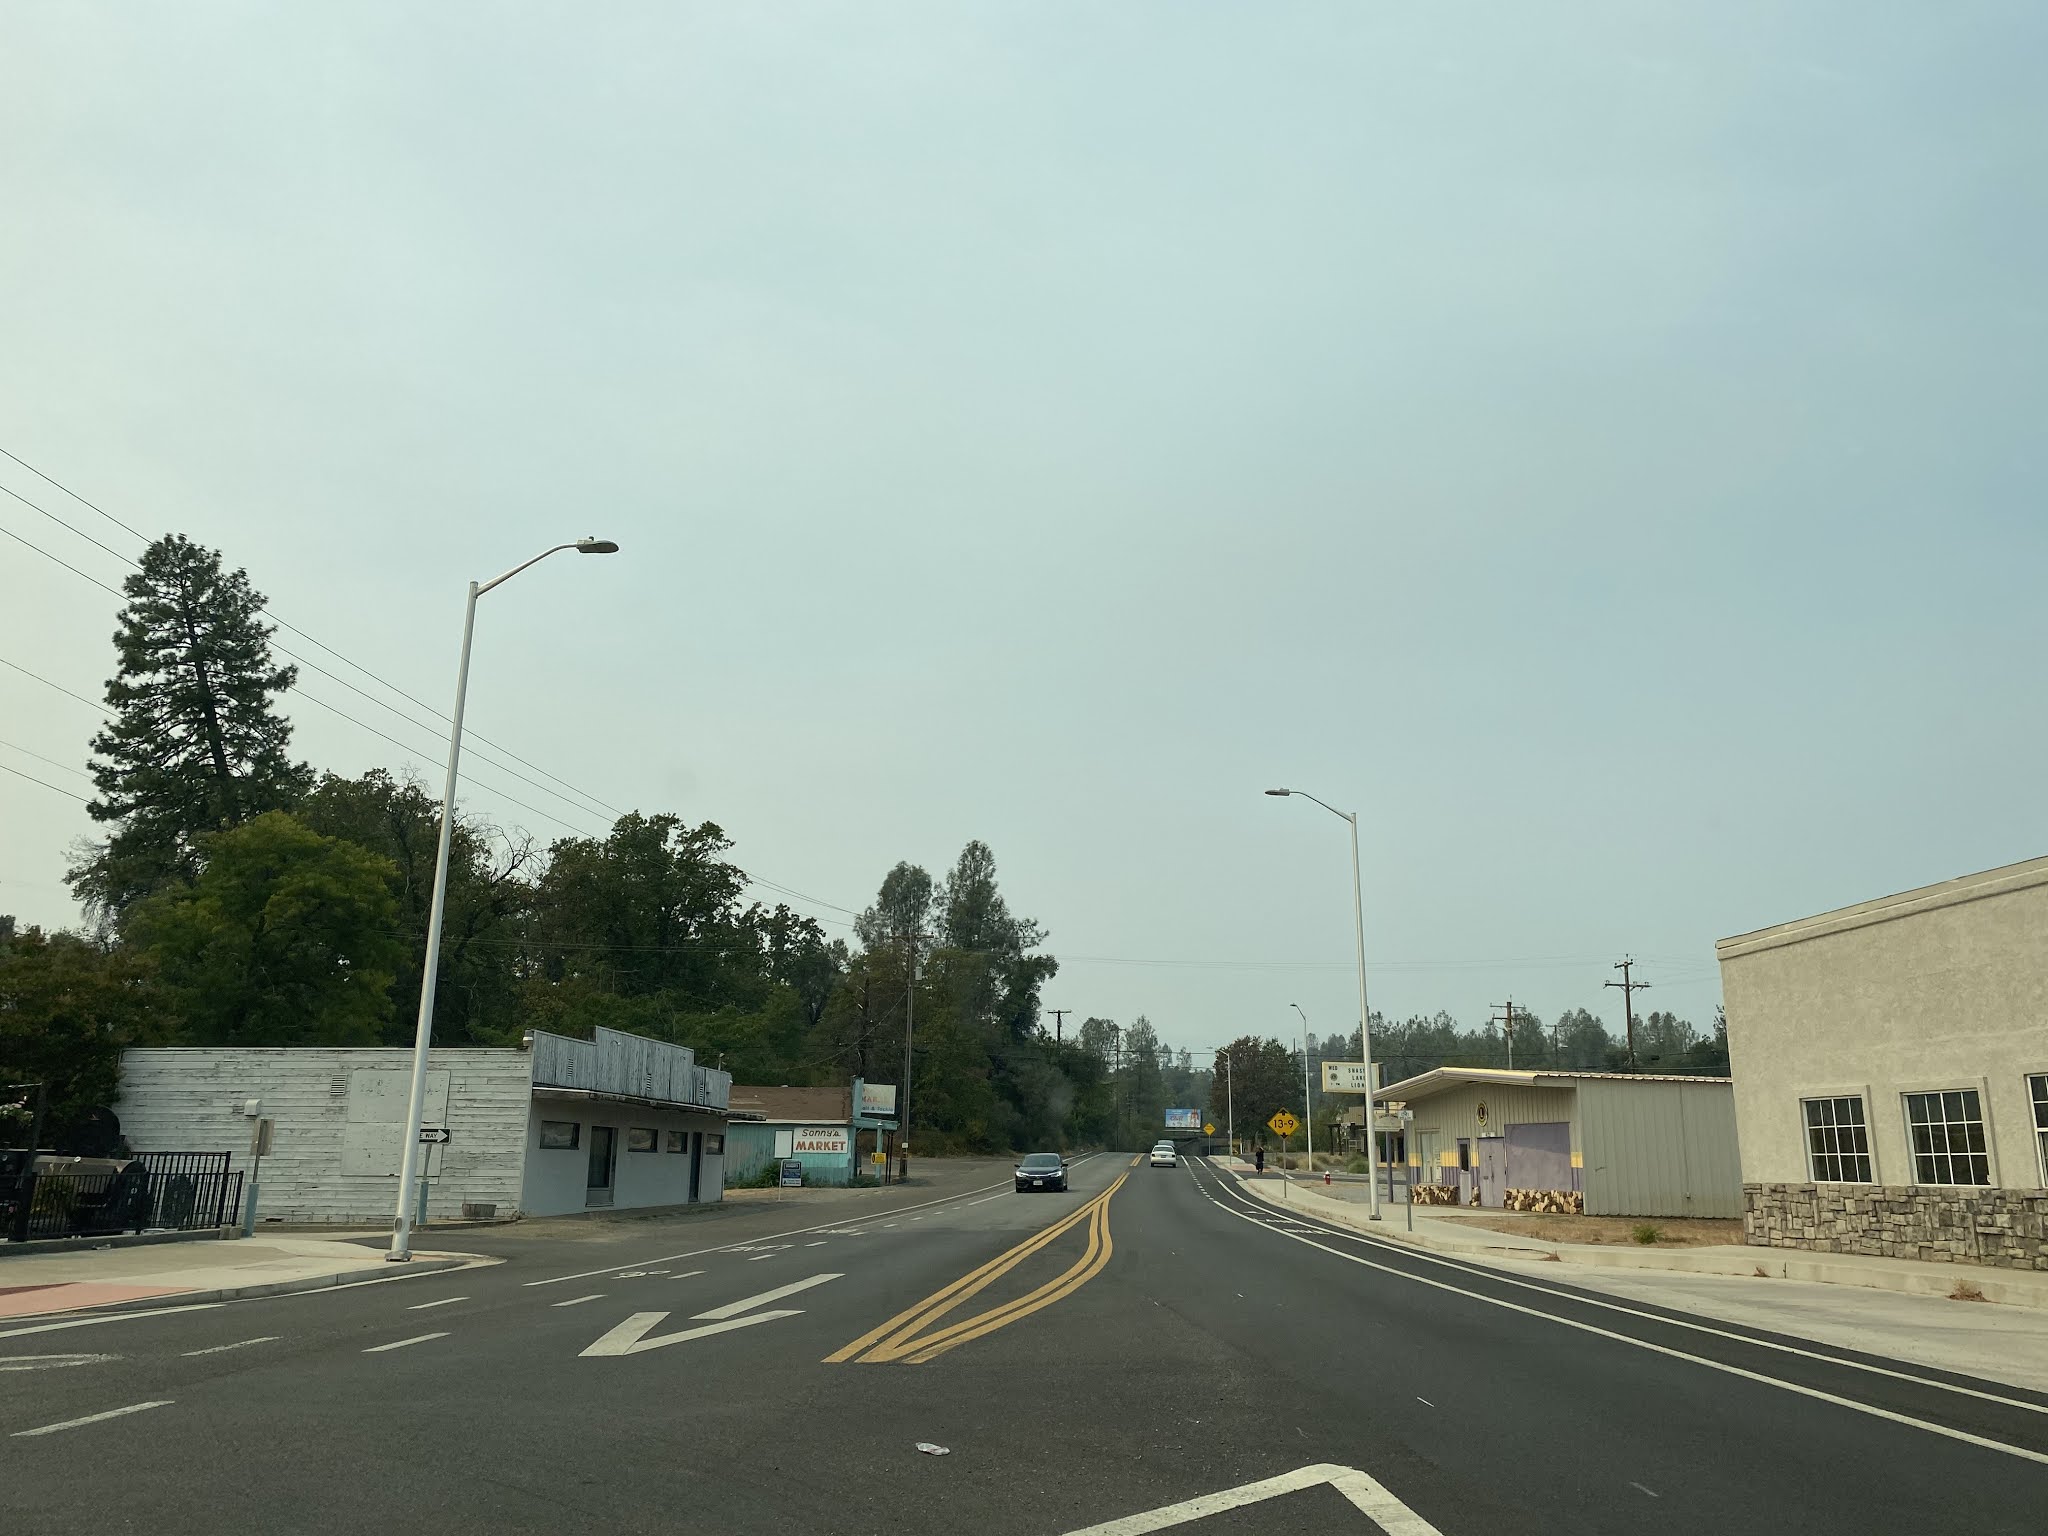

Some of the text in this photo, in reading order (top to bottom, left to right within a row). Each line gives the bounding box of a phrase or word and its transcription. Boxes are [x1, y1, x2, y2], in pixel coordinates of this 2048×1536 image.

[1273, 1119, 1294, 1129] 13-9
[801, 1128, 842, 1137] Sonny's
[795, 1140, 847, 1151] MARKET
